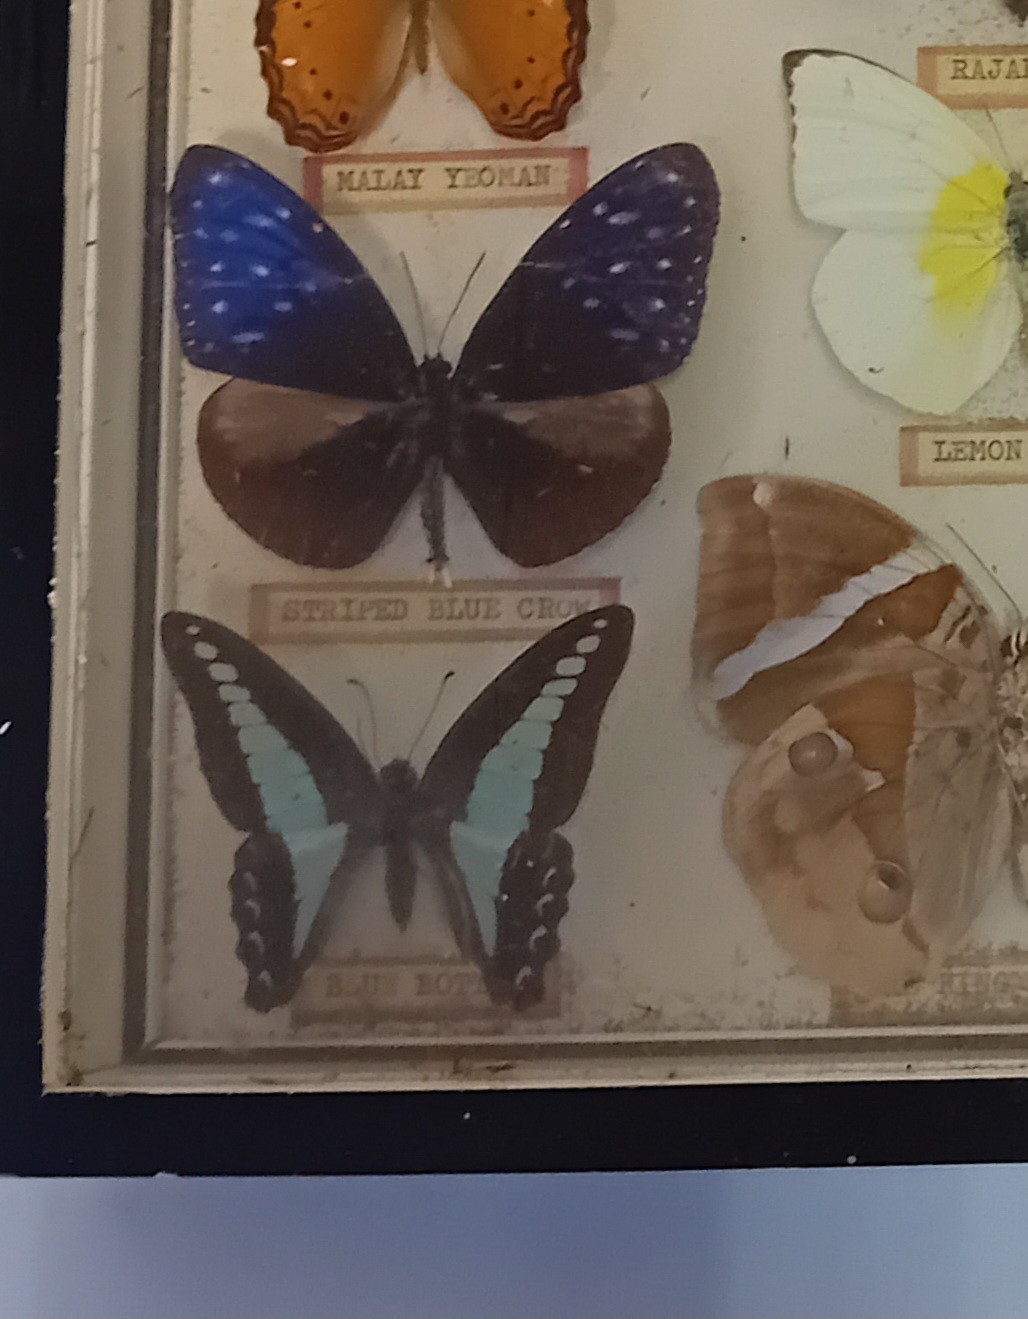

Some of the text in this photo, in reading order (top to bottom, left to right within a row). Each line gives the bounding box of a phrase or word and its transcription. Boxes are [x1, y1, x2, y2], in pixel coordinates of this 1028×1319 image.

[336, 164, 552, 192] MALAY YEOMAN
[933, 439, 1023, 463] LEMON
[281, 597, 408, 623] STRIPED
[426, 597, 502, 621] BLUE
